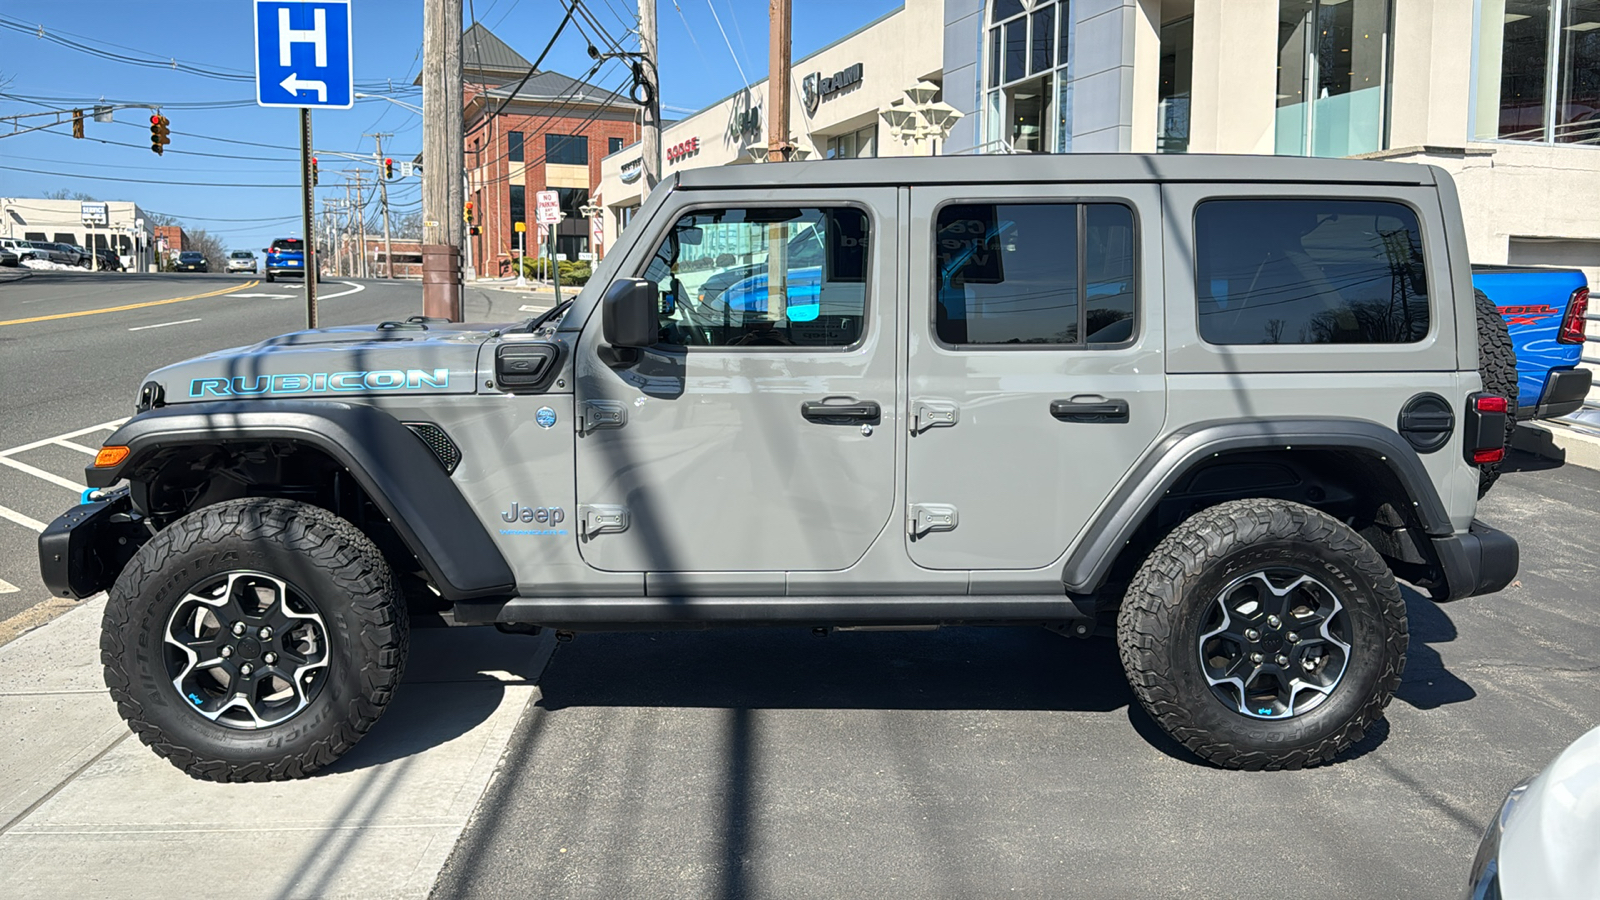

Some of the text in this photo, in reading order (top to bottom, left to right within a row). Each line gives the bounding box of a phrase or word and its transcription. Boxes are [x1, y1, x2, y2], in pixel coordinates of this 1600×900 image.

[278, 8, 327, 67] H
[819, 63, 863, 95] RAM
[667, 137, 699, 160] DODGE
[189, 369, 449, 397] RUBICON
[501, 502, 565, 527] Jeep
